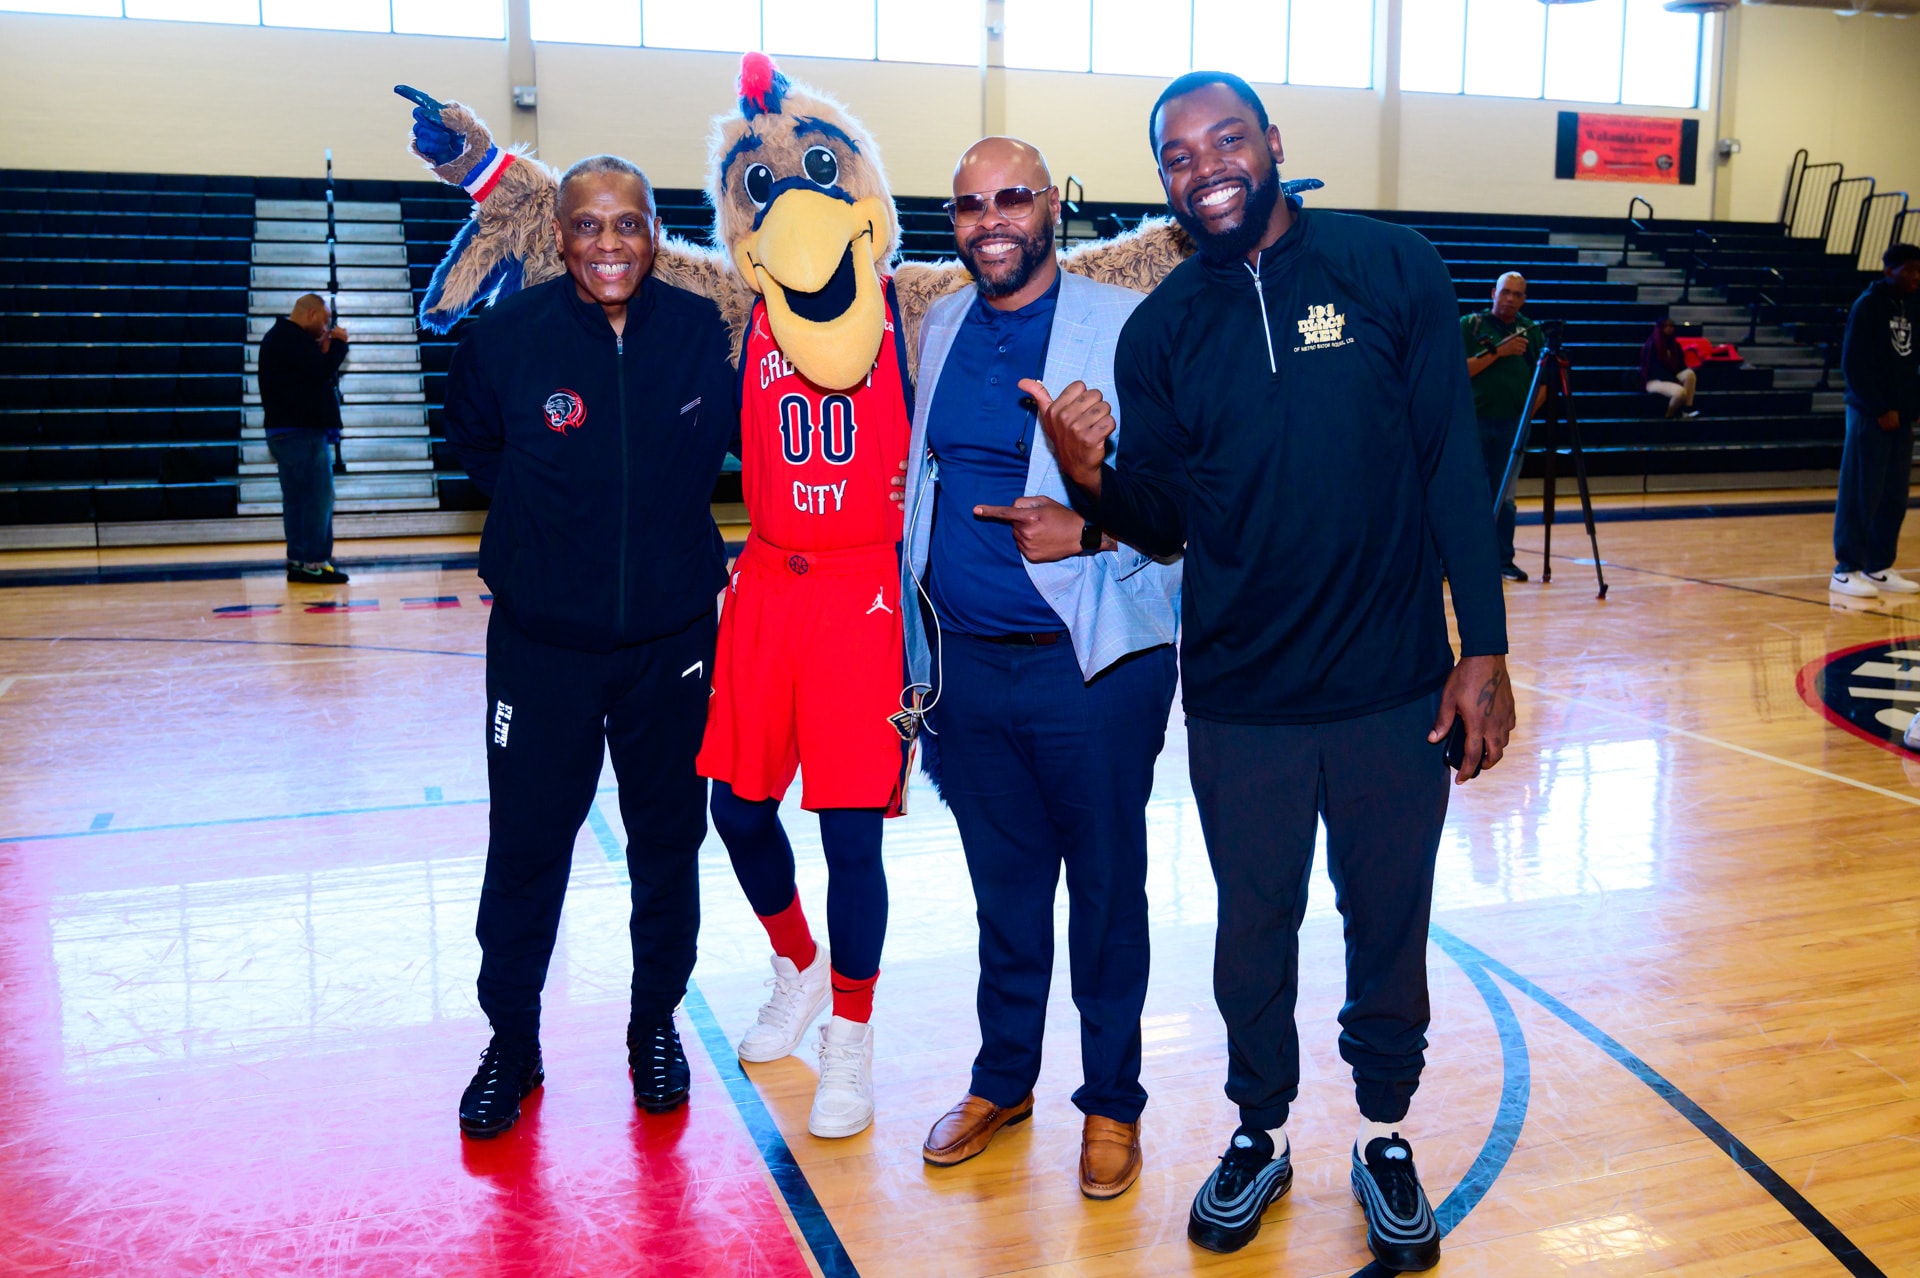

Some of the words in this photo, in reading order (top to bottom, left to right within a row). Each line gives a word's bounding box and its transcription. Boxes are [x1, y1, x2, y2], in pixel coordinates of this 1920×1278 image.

[1297, 313, 1346, 333] BLACK
[1304, 327, 1343, 345] MEN
[779, 393, 858, 465] 00
[793, 479, 848, 515] CITY
